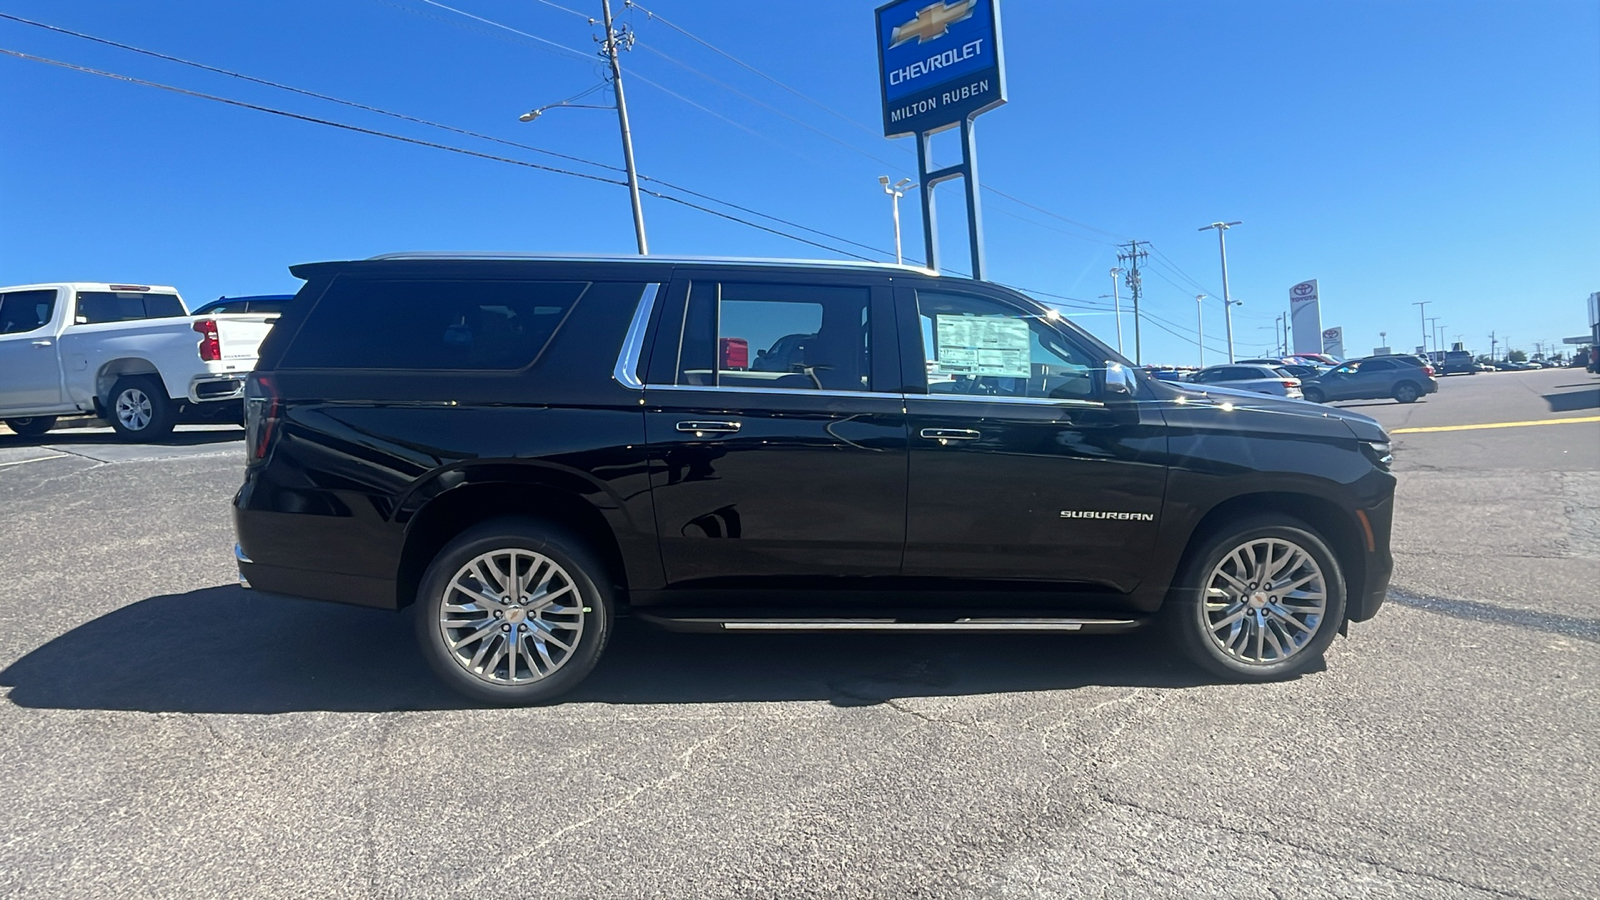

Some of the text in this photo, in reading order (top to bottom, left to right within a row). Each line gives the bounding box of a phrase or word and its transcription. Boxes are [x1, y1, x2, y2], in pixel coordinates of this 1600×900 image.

[889, 38, 983, 86] CHEVROLET
[891, 79, 989, 122] MILTON RUBEN
[1060, 510, 1154, 521] SUBURBAN
